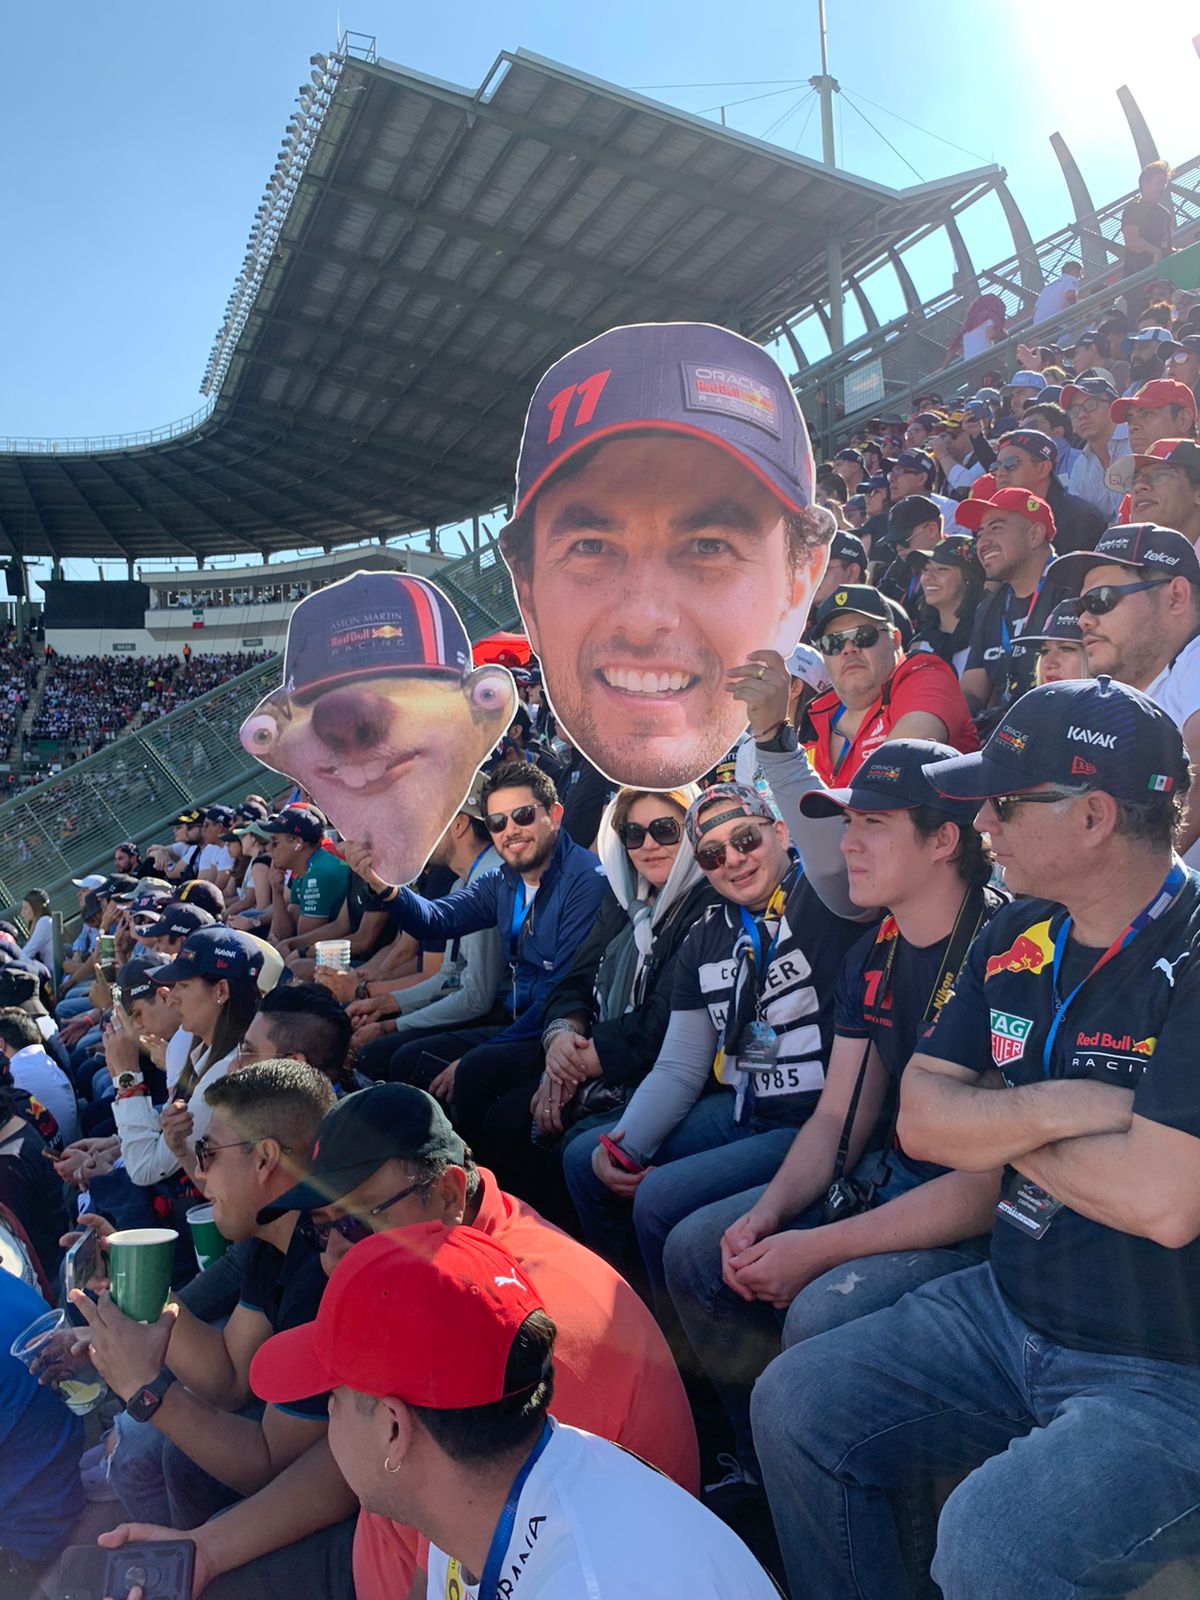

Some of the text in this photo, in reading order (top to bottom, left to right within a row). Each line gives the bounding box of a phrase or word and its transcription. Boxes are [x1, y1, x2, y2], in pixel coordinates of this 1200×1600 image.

[695, 368, 771, 398] ORACLE
[548, 369, 612, 444] 11
[698, 395, 775, 424] RACING
[1144, 549, 1180, 566] telcel
[330, 612, 402, 631] ASTON MARTIN
[331, 639, 405, 656] RACING
[1002, 725, 1029, 742] ORACLE
[1067, 725, 1118, 750] KAVAK
[870, 765, 901, 773] ORACLE
[767, 960, 800, 989] ER
[932, 971, 954, 1010] Nikon
[1076, 1031, 1131, 1050] Red Bull
[753, 1068, 800, 1092] 1985
